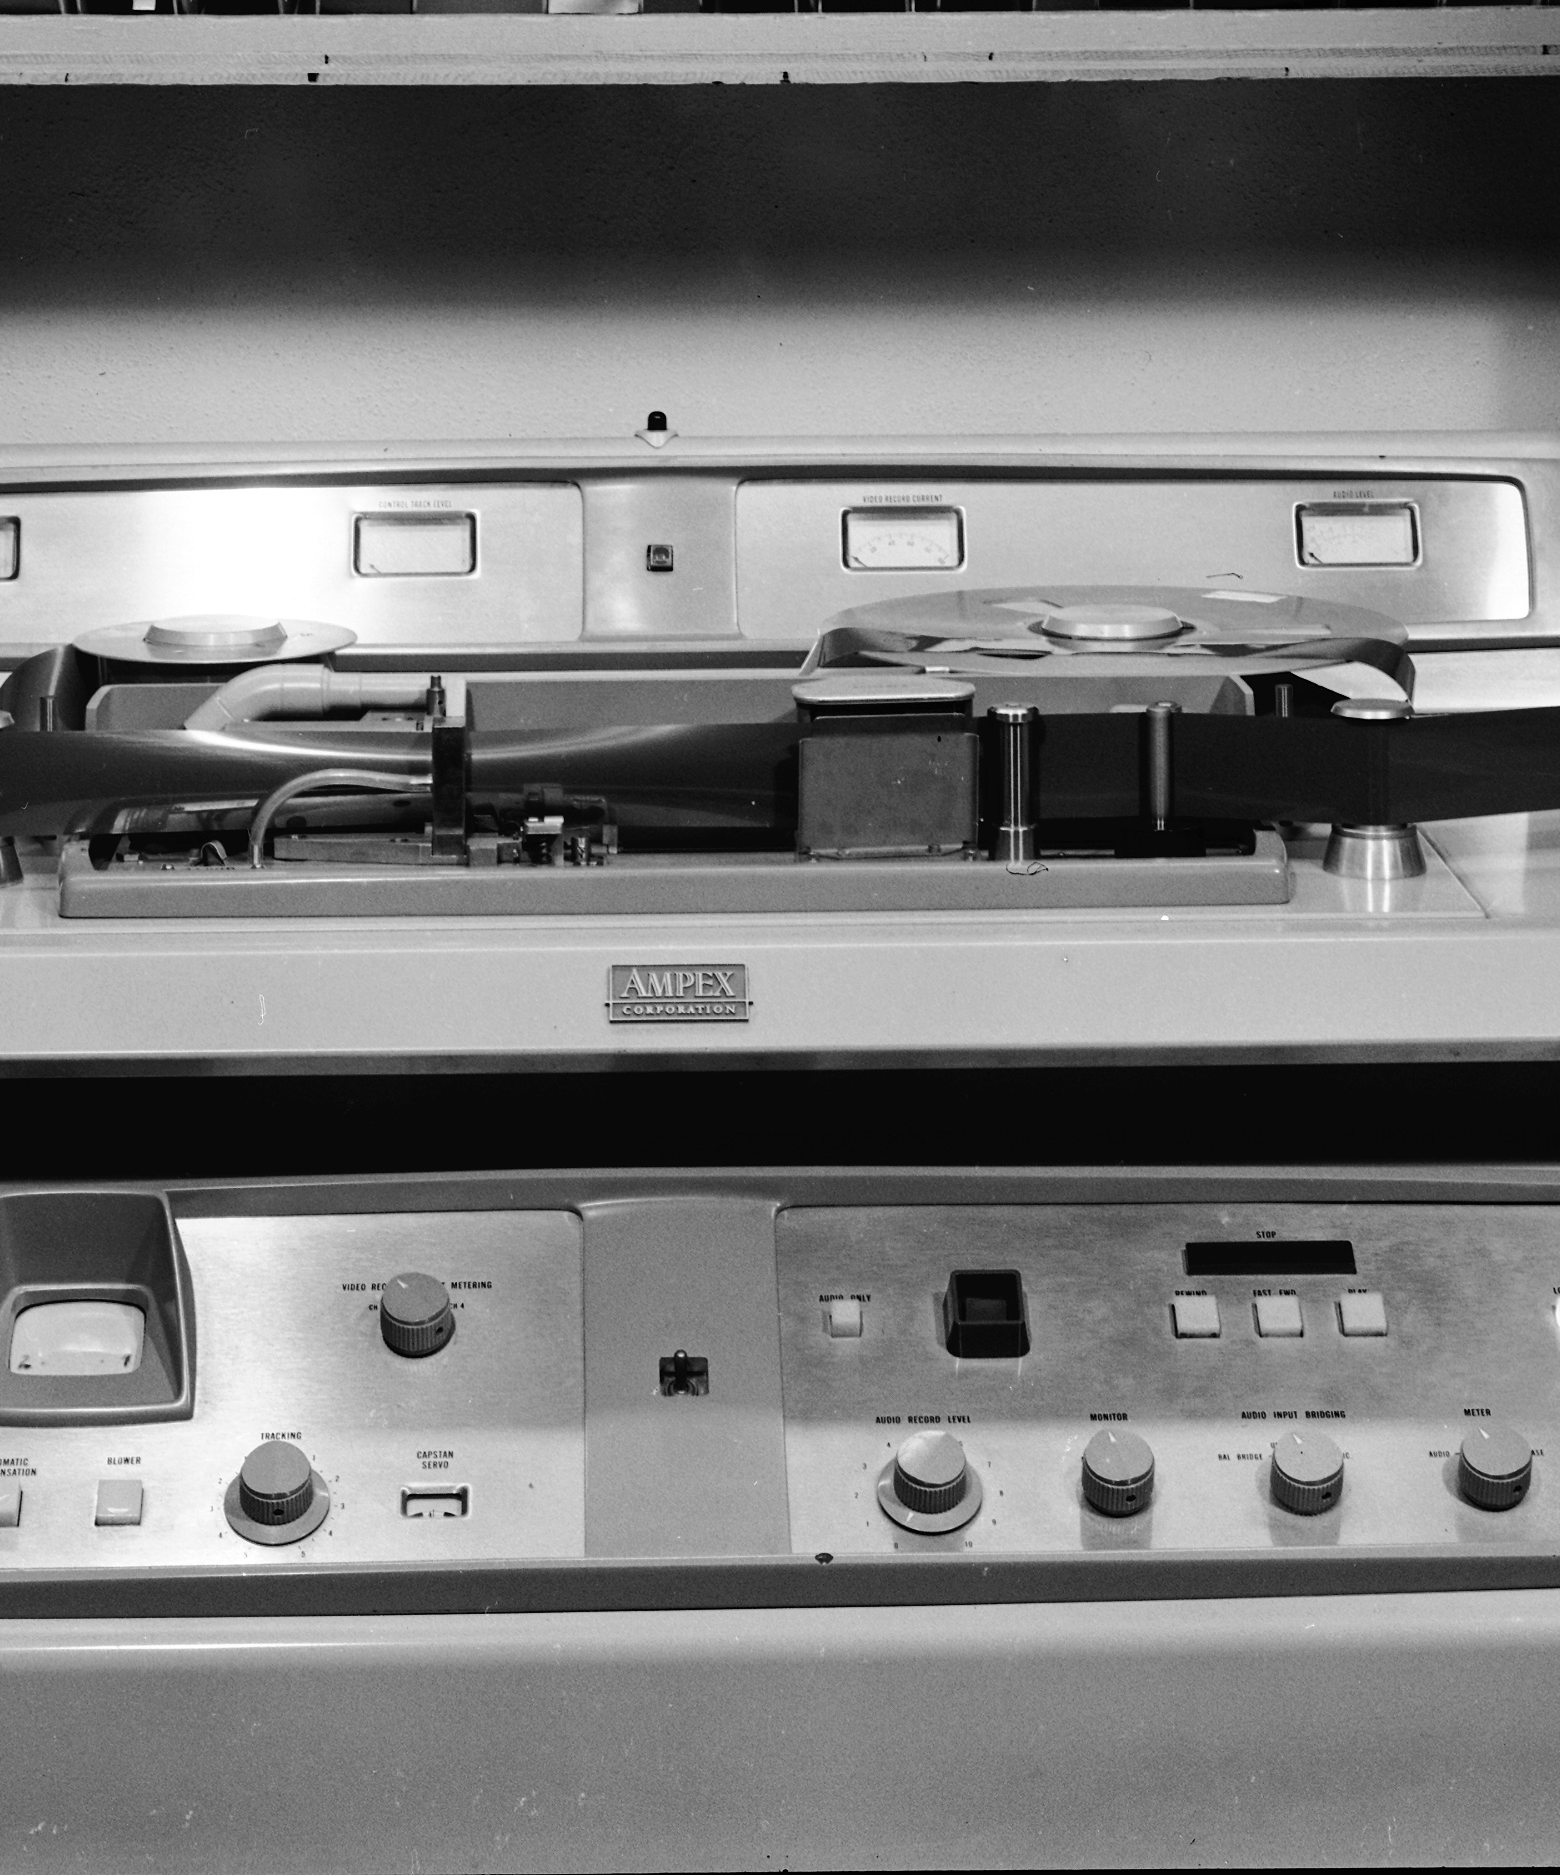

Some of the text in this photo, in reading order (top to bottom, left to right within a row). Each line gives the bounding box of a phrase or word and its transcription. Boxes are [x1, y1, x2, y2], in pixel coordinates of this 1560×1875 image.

[862, 494, 943, 504] VIDEO RECORD CURRENT
[1333, 490, 1353, 499] AUDIO
[619, 968, 736, 999] AMPEX
[622, 1005, 737, 1016] CORPORATION
[1256, 1230, 1277, 1239] STOP
[342, 1281, 493, 1291] VIDEO METERING
[1090, 1412, 1128, 1422] MONITOR
[1241, 1410, 1346, 1420] AUDIO INPUT BRIDGING
[1463, 1408, 1492, 1417] METER
[875, 1415, 971, 1424] AUDIO RECORD LEVEL
[260, 1431, 302, 1440] TRACKING
[416, 1451, 454, 1459] CAPSTAN
[1237, 1453, 1263, 1461] BRIDGE
[107, 1457, 141, 1465] BLOWER
[422, 1461, 449, 1469] SERVO
